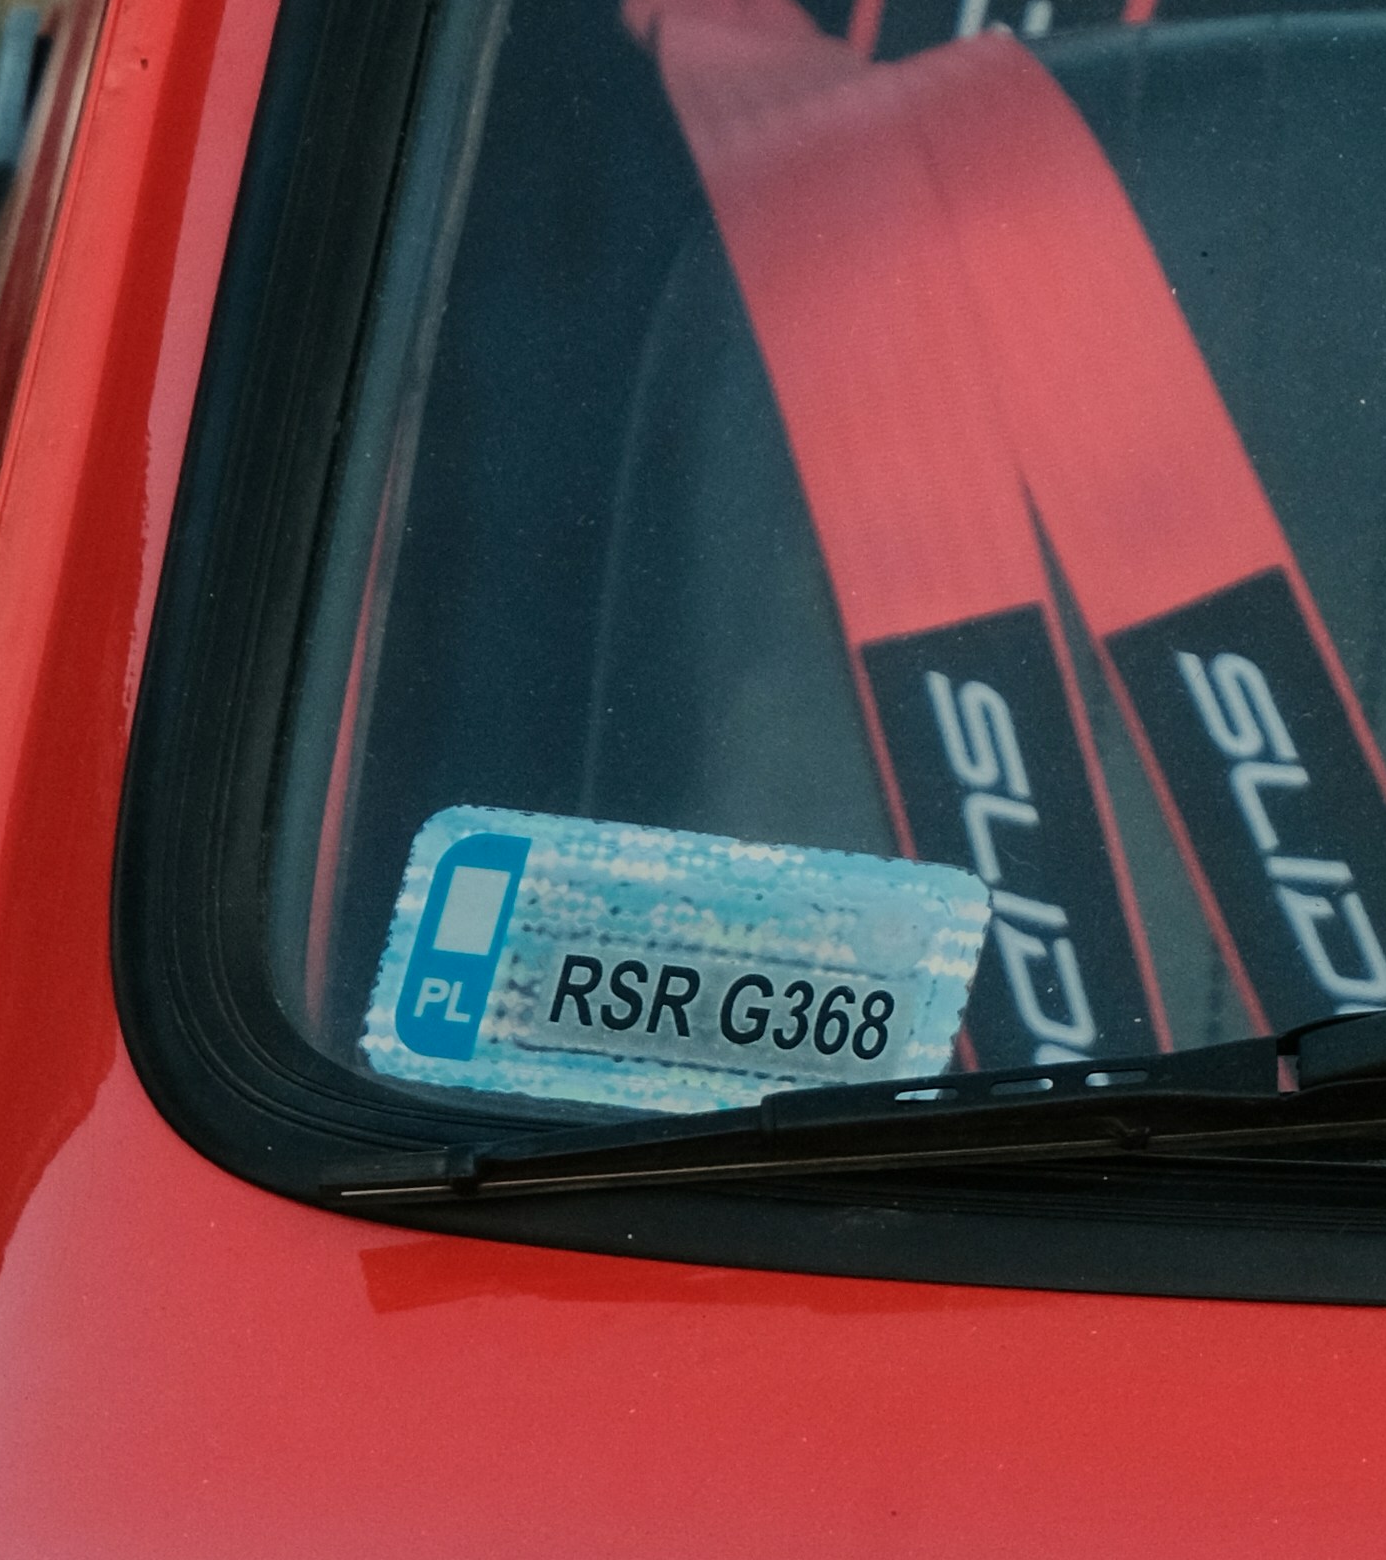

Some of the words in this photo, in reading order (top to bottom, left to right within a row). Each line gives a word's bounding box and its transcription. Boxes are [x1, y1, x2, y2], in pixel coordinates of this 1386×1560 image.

[924, 670, 1096, 1066] SLID
[412, 977, 472, 1024] PL
[549, 954, 700, 1038] RSR
[719, 973, 895, 1061] G368
